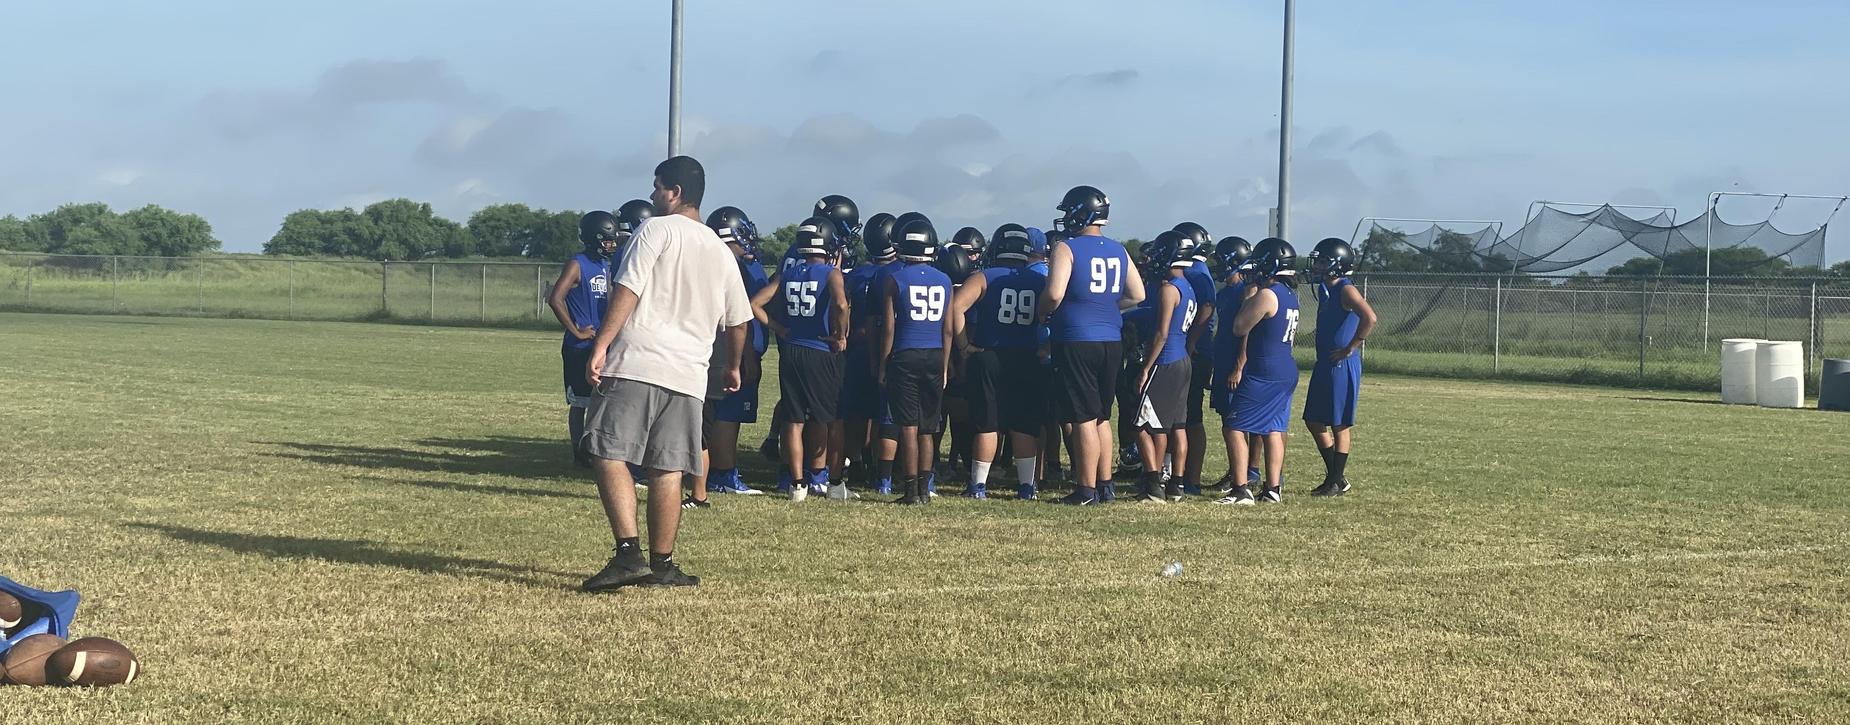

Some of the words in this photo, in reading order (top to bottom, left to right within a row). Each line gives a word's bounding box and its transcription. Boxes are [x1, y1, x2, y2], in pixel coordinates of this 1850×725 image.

[1090, 257, 1121, 294] 97
[786, 281, 818, 317] 55
[909, 285, 945, 322] 59
[997, 288, 1036, 325] 89
